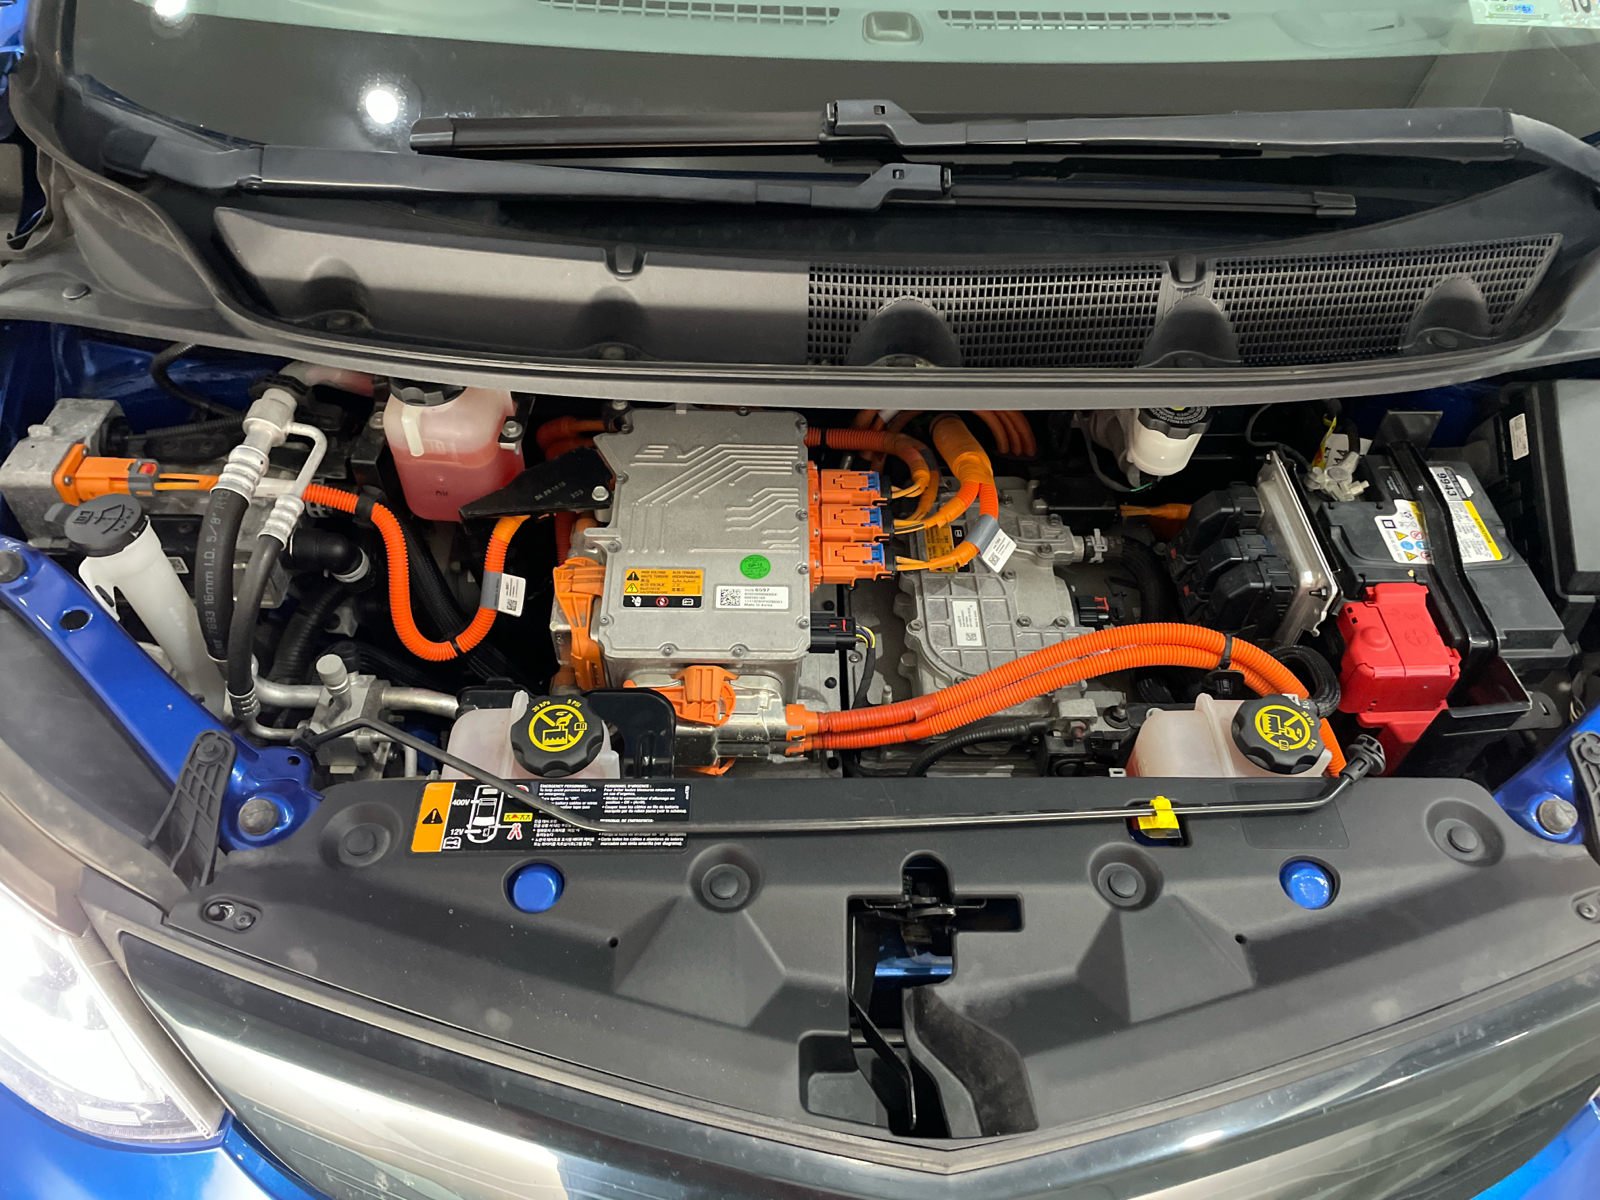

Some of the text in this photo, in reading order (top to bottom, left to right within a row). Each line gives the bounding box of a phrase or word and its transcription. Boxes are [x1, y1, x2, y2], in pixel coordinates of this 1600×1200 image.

[1436, 472, 1458, 496] 9943
[204, 548, 215, 566] I.D.
[204, 571, 214, 605] 16mm
[205, 610, 218, 634] 7693
